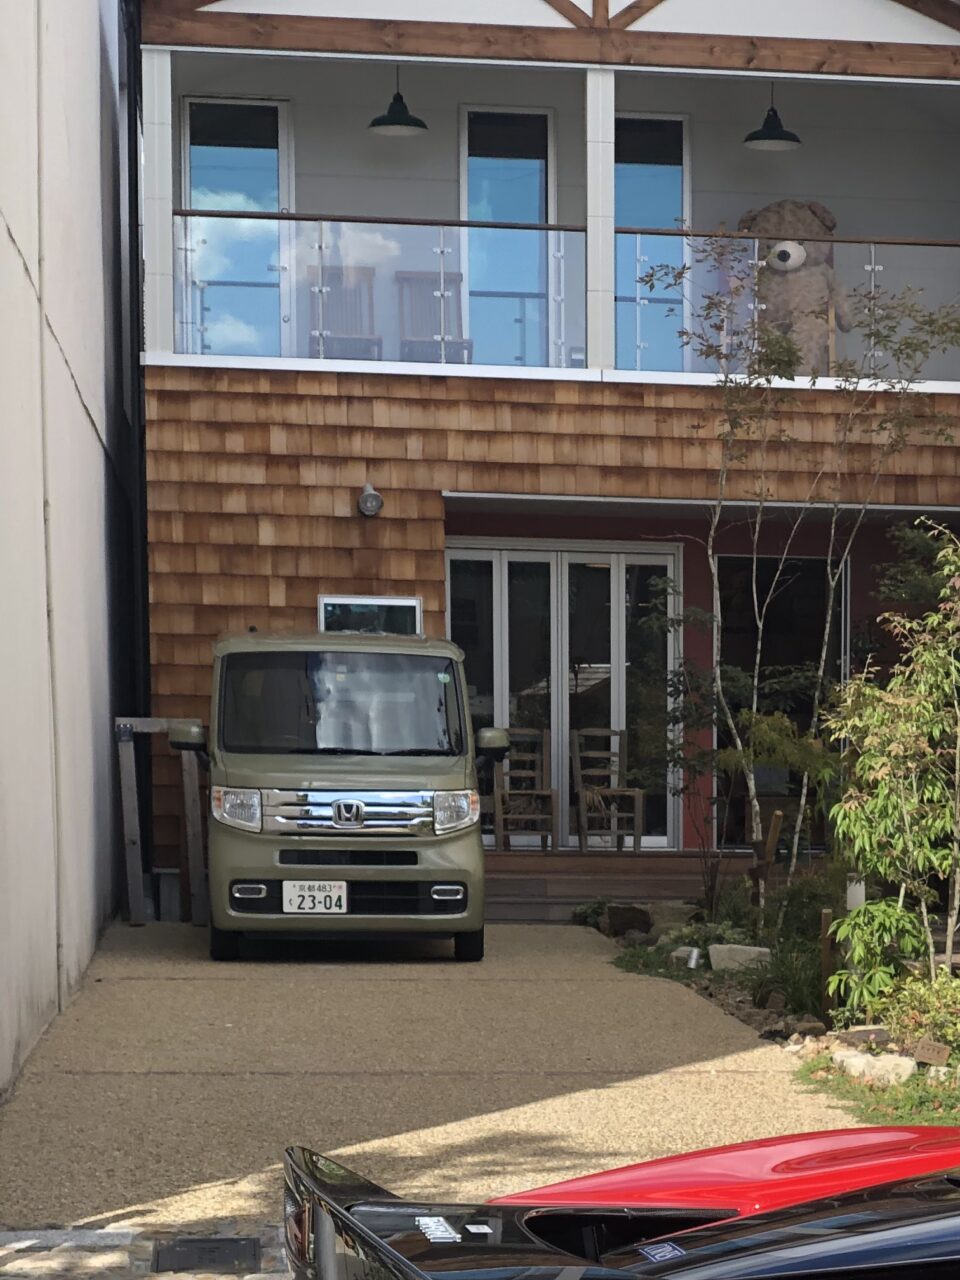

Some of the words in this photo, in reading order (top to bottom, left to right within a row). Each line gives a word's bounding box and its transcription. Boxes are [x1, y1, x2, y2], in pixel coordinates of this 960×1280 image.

[298, 884, 316, 892] 京都
[316, 884, 333, 893] 483
[297, 894, 343, 910] 23-04
